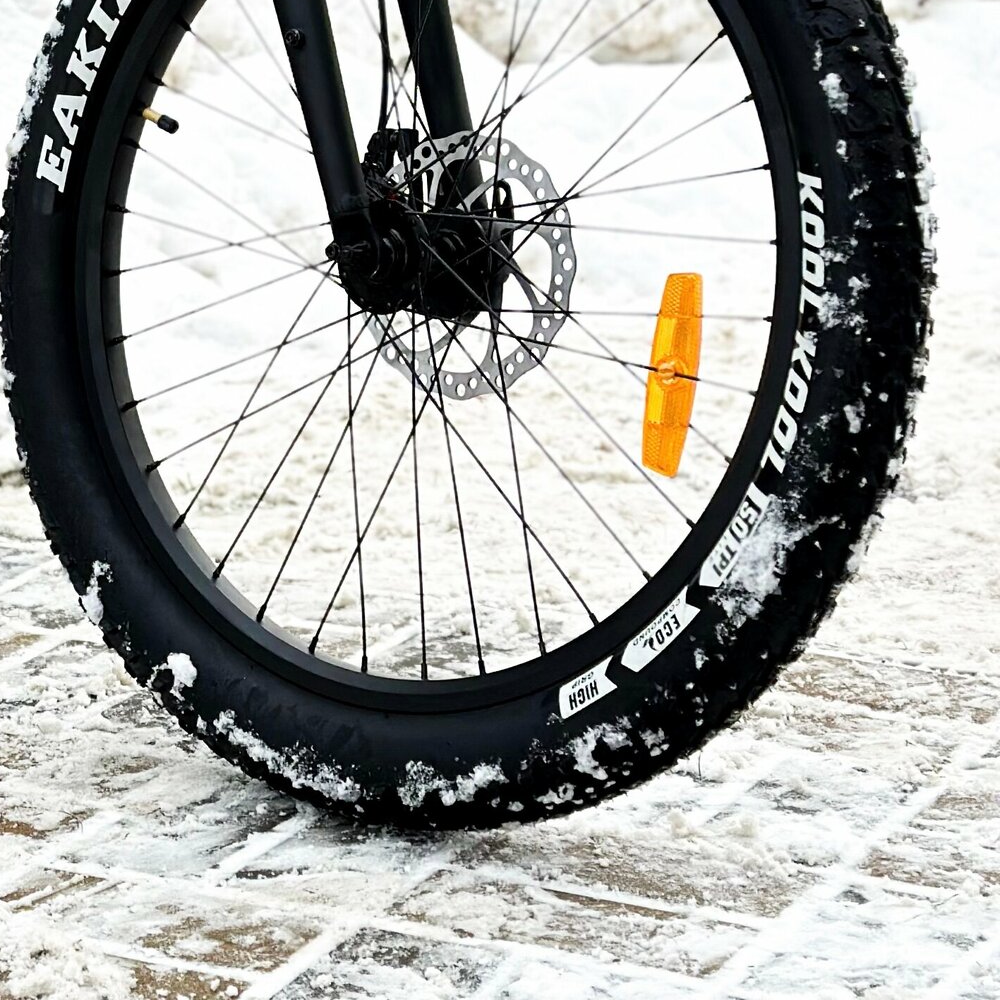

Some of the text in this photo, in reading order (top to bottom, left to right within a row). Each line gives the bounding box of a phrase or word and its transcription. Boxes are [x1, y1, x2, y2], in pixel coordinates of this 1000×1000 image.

[797, 171, 826, 314] KOOL
[761, 330, 817, 474] KOOL
[713, 545, 738, 577] TPI
[632, 597, 681, 647] COMPOUND
[656, 614, 681, 646] ECO
[568, 680, 599, 711] HIGH
[571, 671, 595, 690] GRIP
